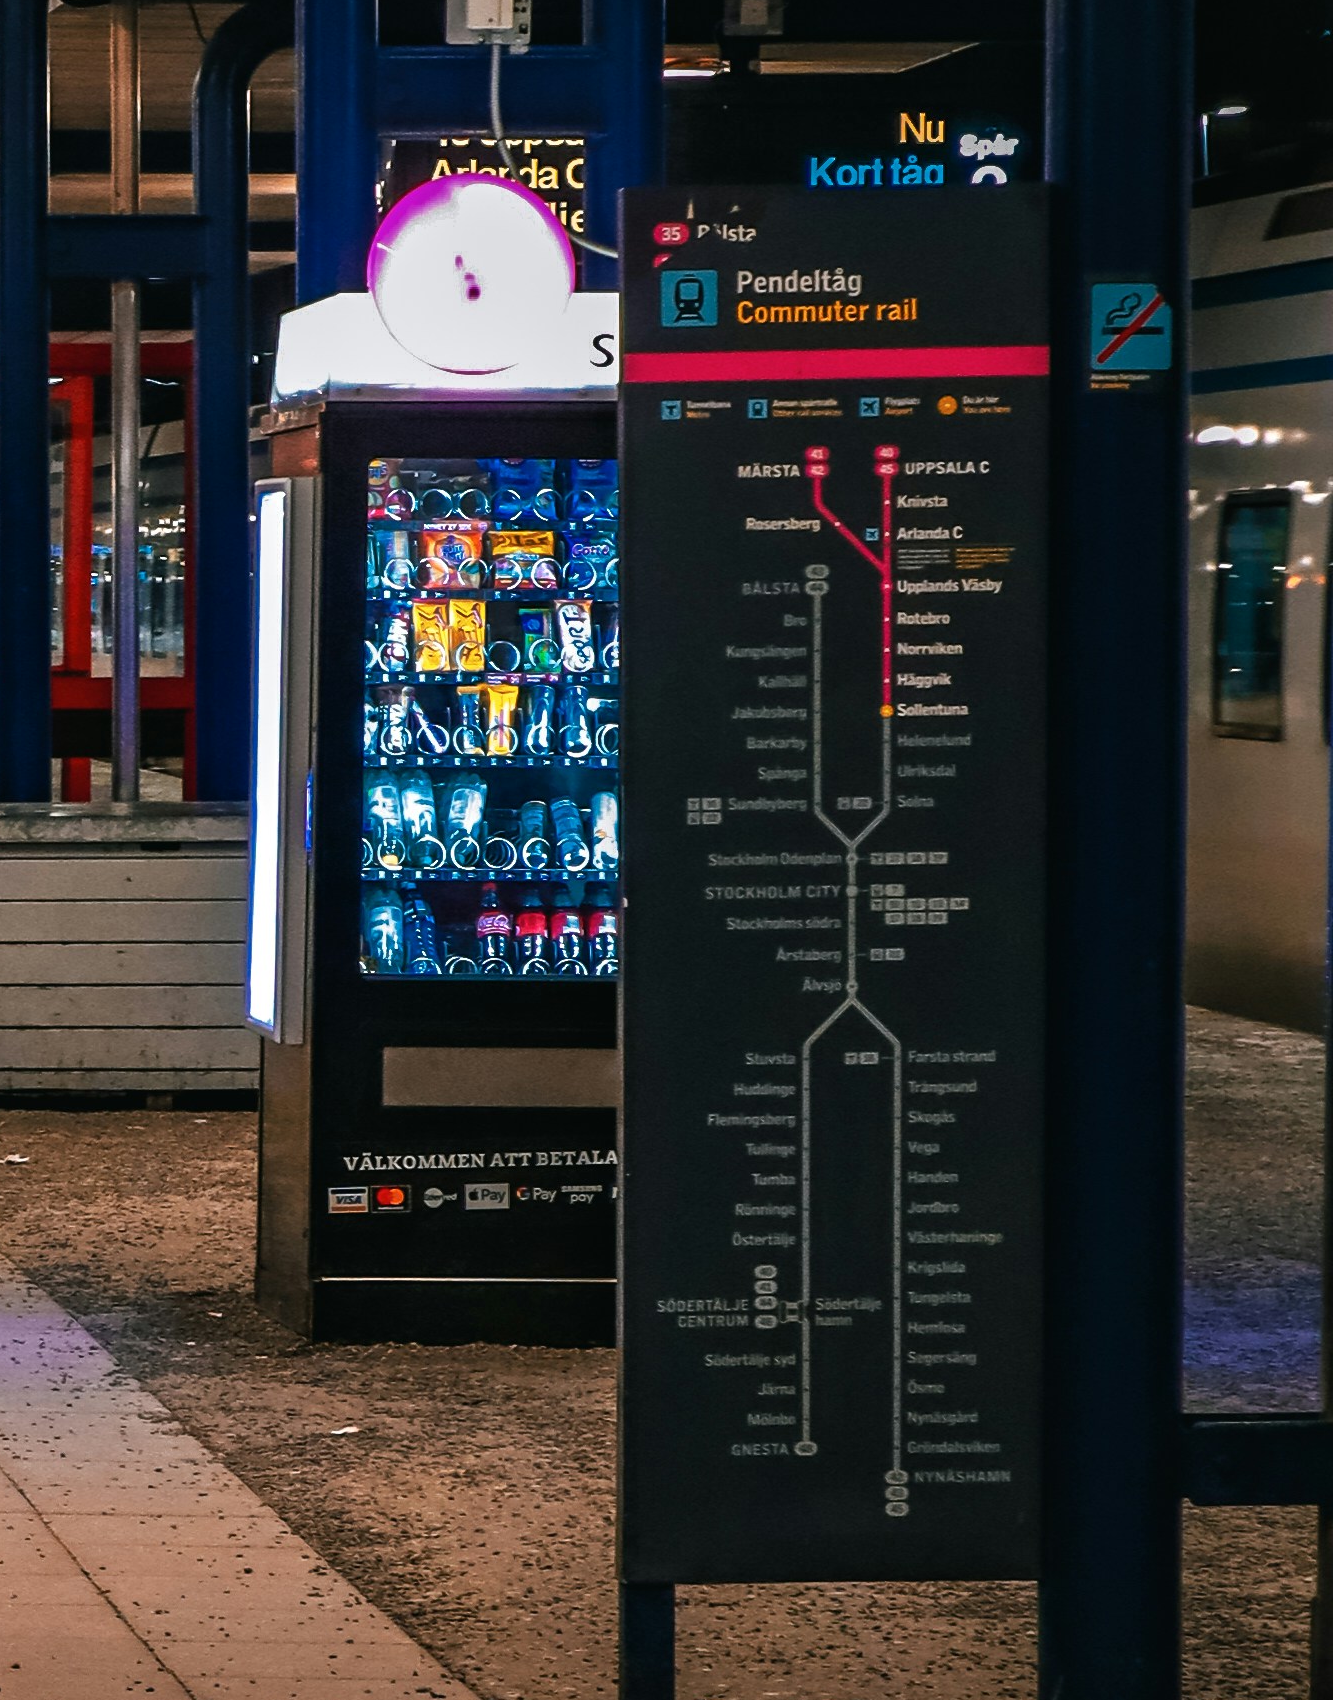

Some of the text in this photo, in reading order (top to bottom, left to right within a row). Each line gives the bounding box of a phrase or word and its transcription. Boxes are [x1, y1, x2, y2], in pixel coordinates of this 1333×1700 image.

[899, 114, 945, 144] Nu
[811, 156, 882, 187] Kort
[890, 154, 945, 185] tåg
[661, 227, 681, 241] 35
[737, 269, 862, 296] Pendeltåg
[738, 298, 917, 324] Commuter rail
[738, 462, 800, 478] MÄRSTA
[905, 461, 990, 475] UPPSALA C
[897, 495, 948, 507] Knivsta
[746, 517, 820, 532] Rosersberg
[897, 526, 963, 539] Arlanda C
[897, 578, 1002, 594] Upplands Väsby
[897, 612, 950, 625] Rotebro
[897, 673, 951, 687] Häggvik
[897, 704, 968, 716] Sollentuna
[343, 1150, 618, 1171] VÄLKOMMEN ATT BETALA
[335, 1195, 362, 1204] VISA
[481, 1189, 506, 1203] Pay
[534, 1187, 557, 1202] Pay
[570, 1193, 594, 1204] pay
